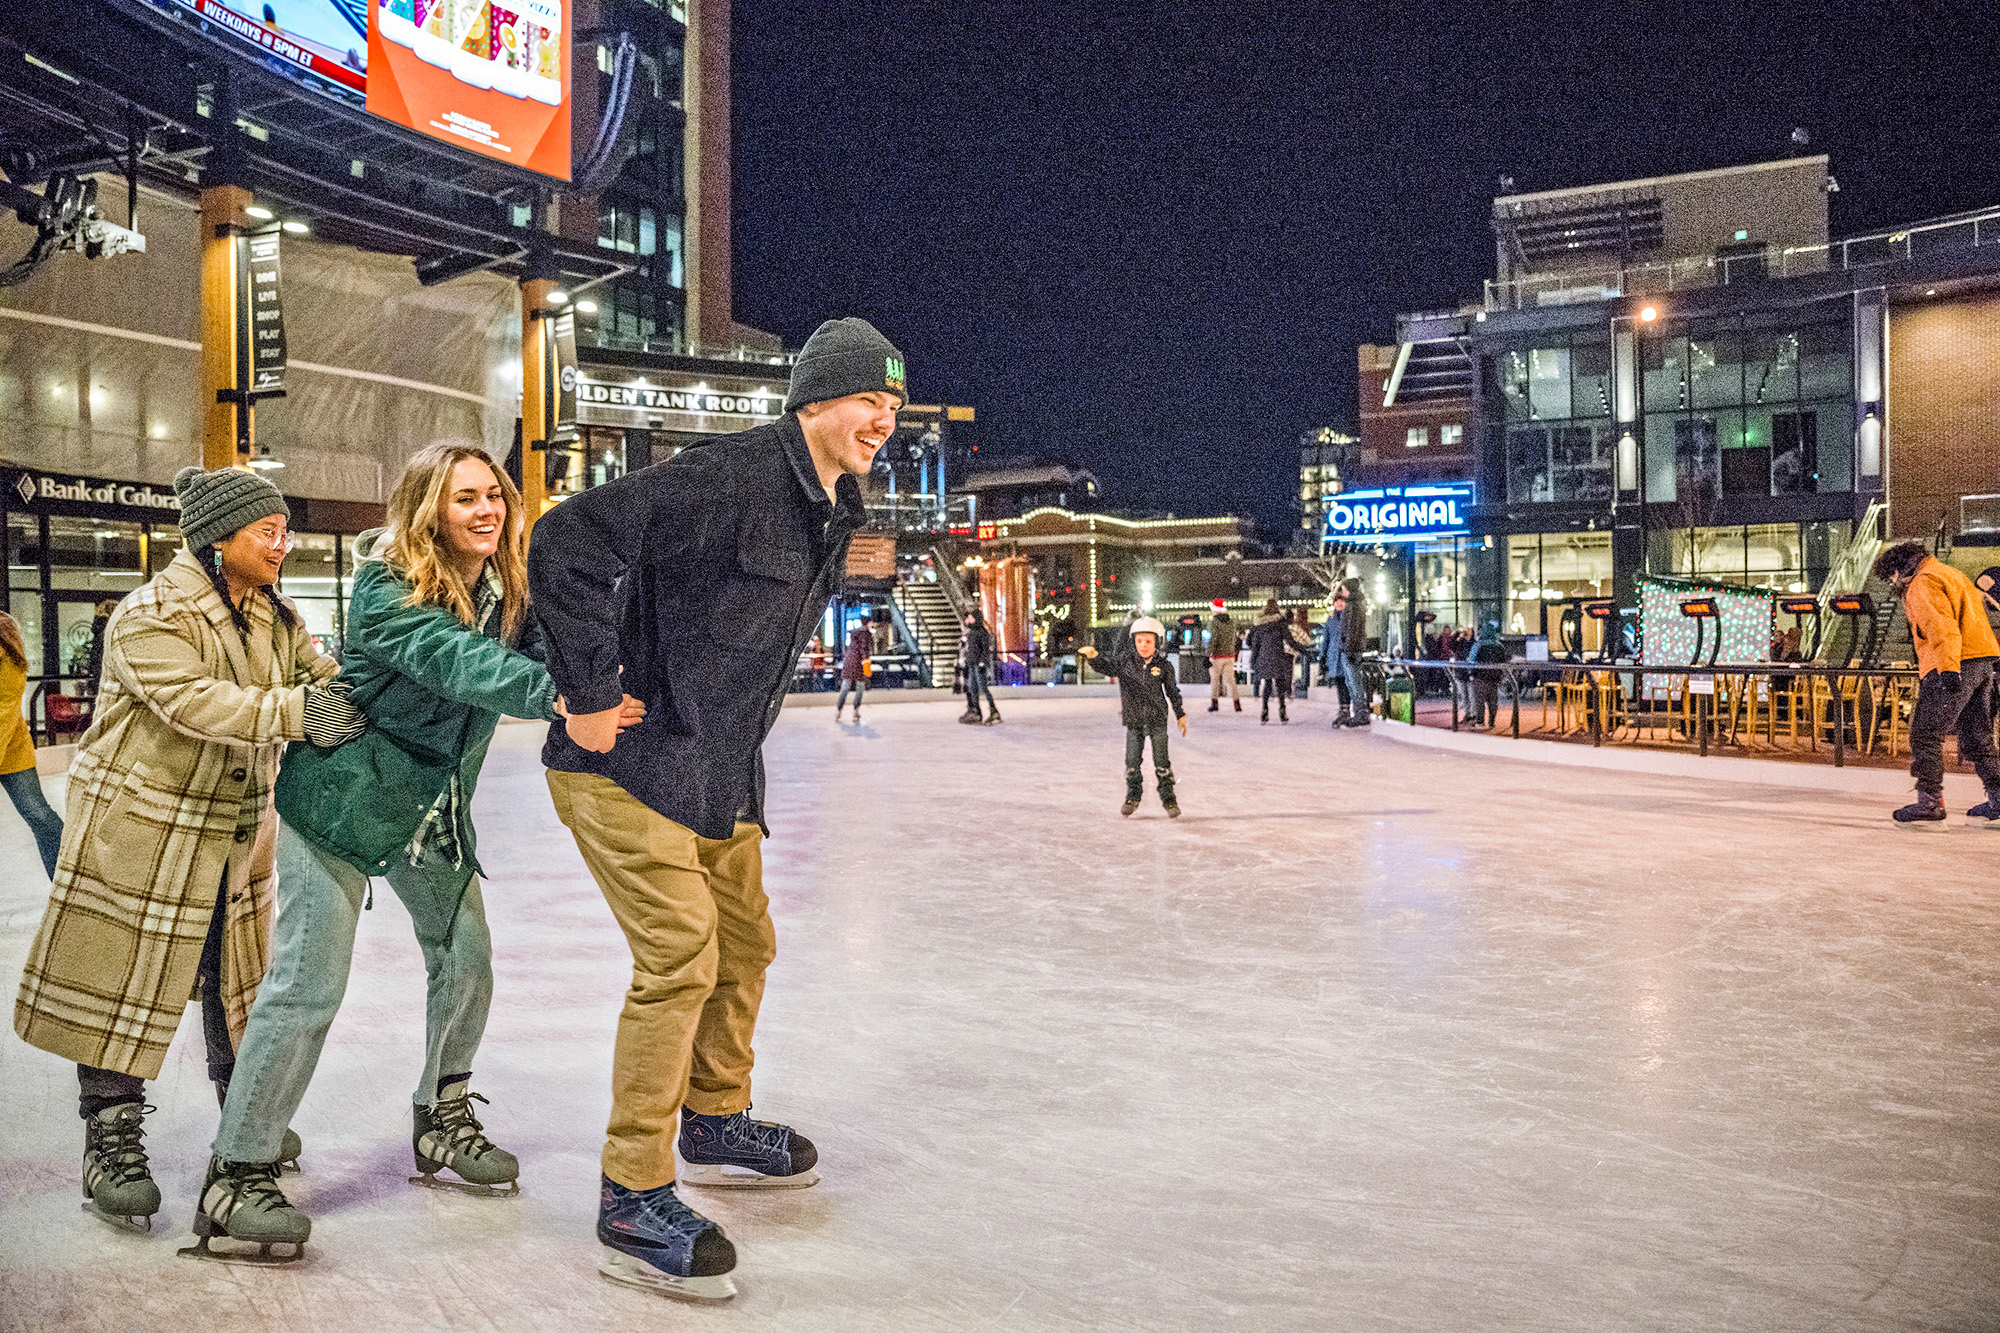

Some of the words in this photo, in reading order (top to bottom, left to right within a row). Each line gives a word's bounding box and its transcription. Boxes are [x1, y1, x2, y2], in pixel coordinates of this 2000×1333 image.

[203, 0, 262, 42] WEEKDAYS
[261, 33, 274, 47] @
[273, 38, 301, 62] 5PM
[299, 50, 314, 67] ET
[576, 384, 638, 405] LDEN
[642, 390, 701, 410] TANK
[705, 395, 769, 414] ROOM
[40, 477, 93, 502] Bank
[95, 483, 117, 504] of
[118, 485, 183, 510] Colora
[1328, 499, 1464, 531] ORIGINAL
